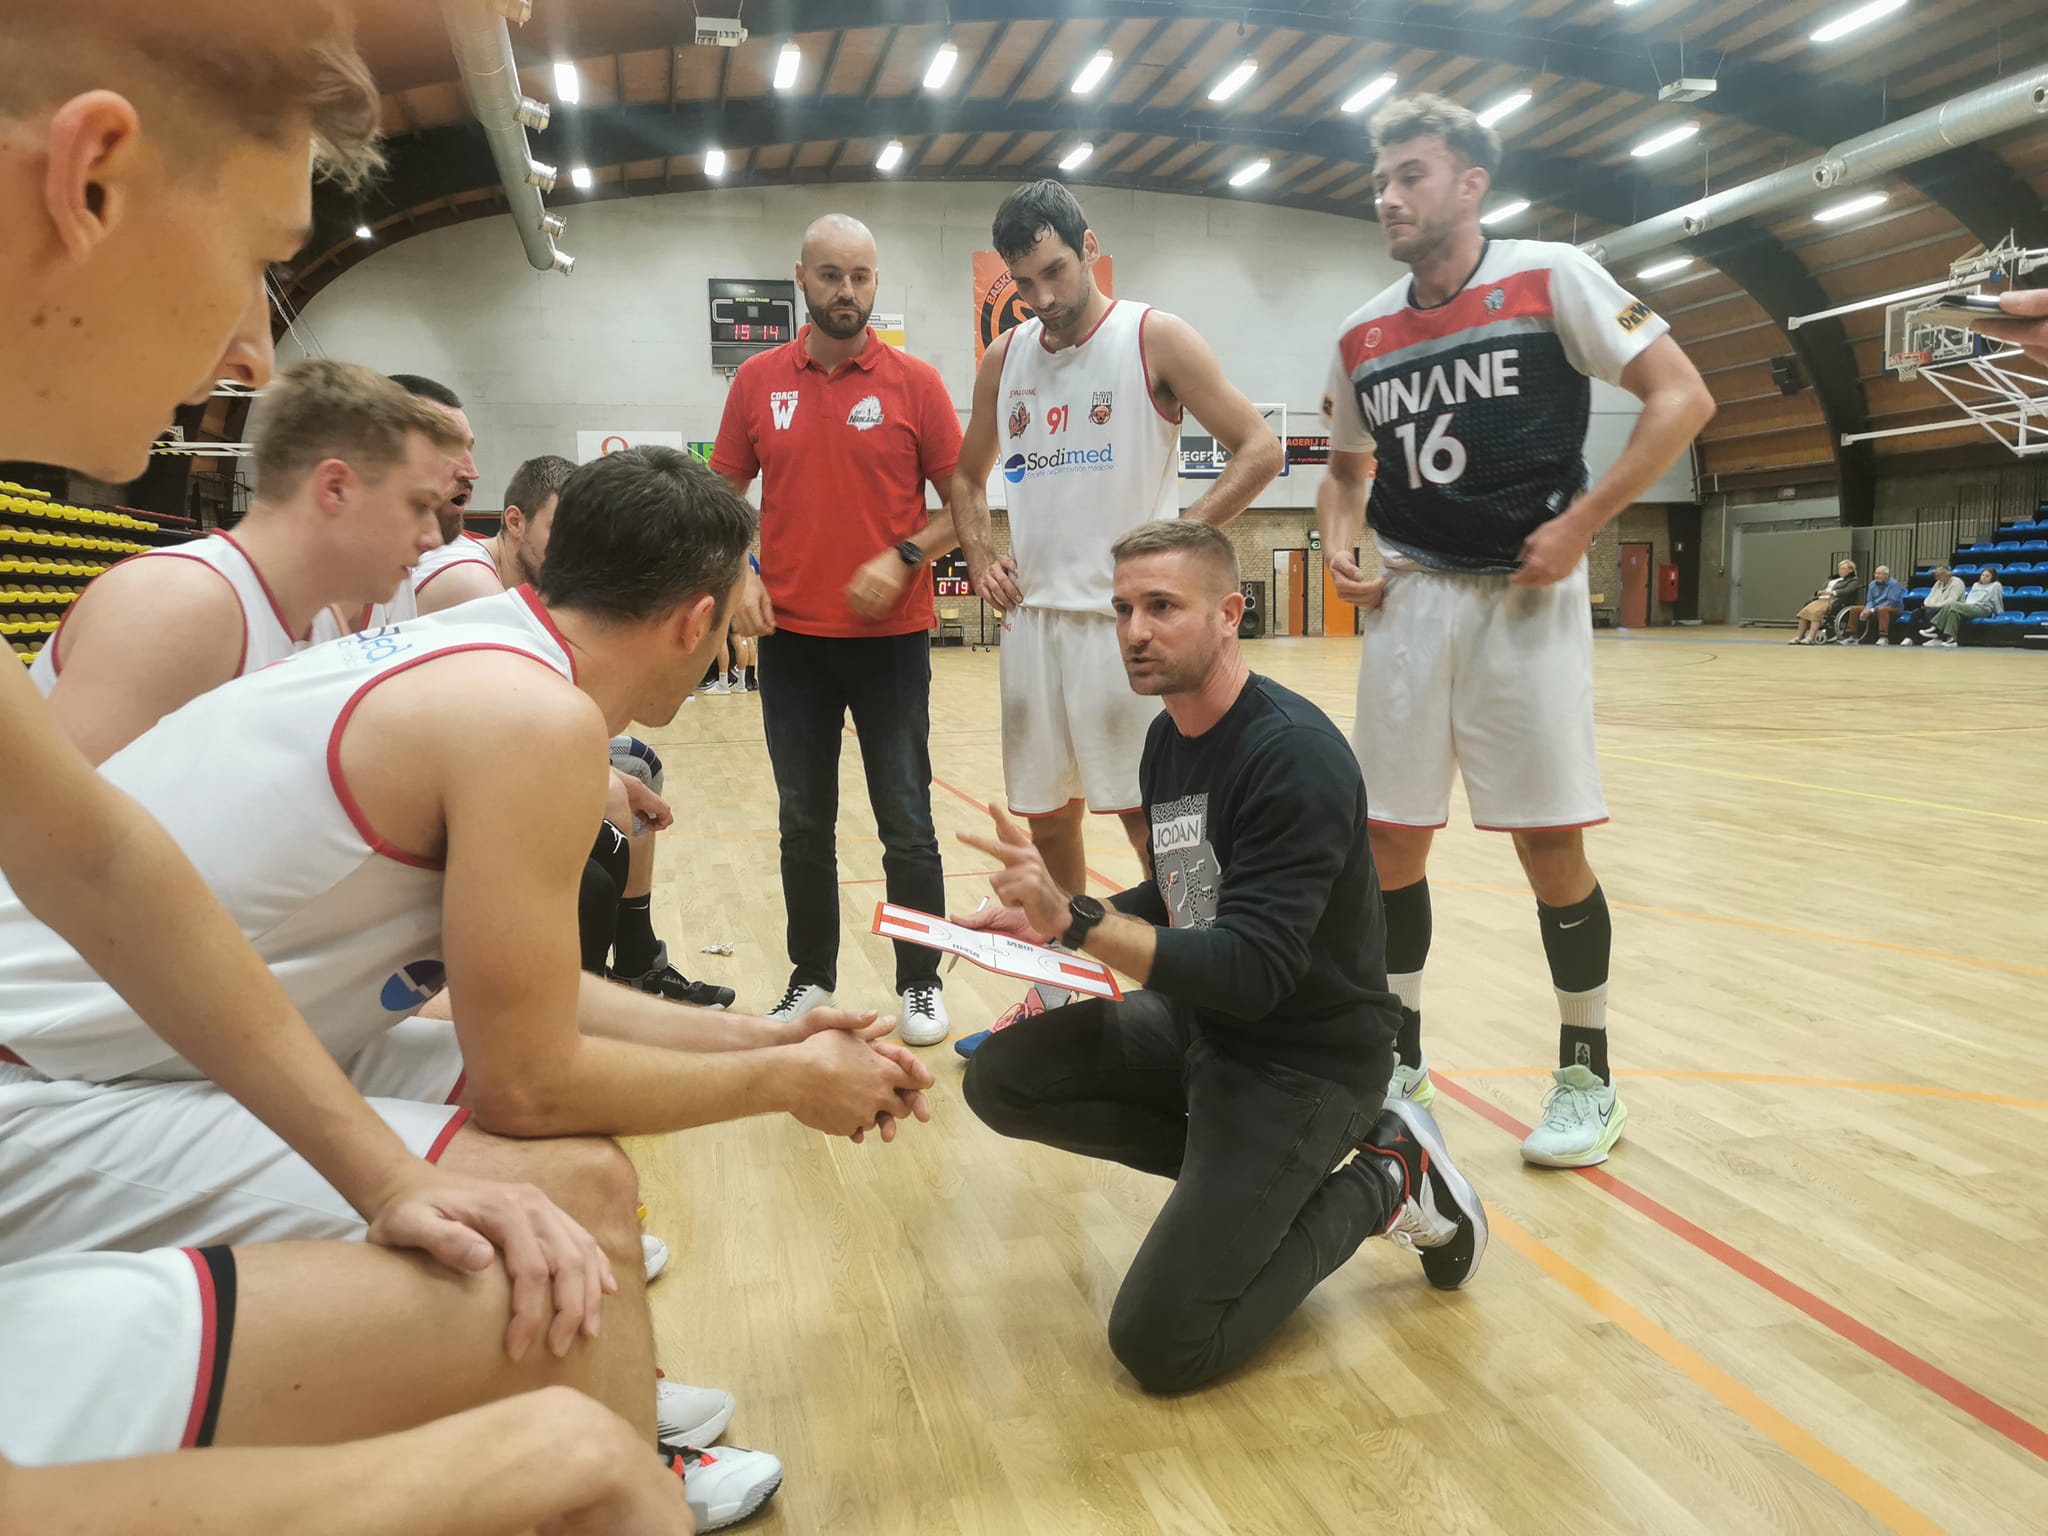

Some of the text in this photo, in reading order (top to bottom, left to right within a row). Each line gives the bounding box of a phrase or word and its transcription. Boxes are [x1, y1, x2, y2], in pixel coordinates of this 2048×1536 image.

[735, 324, 750, 340] 15
[763, 325, 779, 340] 14
[770, 391, 799, 400] COACH
[1361, 349, 1520, 431] NINANE
[770, 399, 798, 430] W
[1046, 404, 1068, 435] 91
[1027, 443, 1113, 471] Sodimed
[1394, 412, 1467, 489] 16
